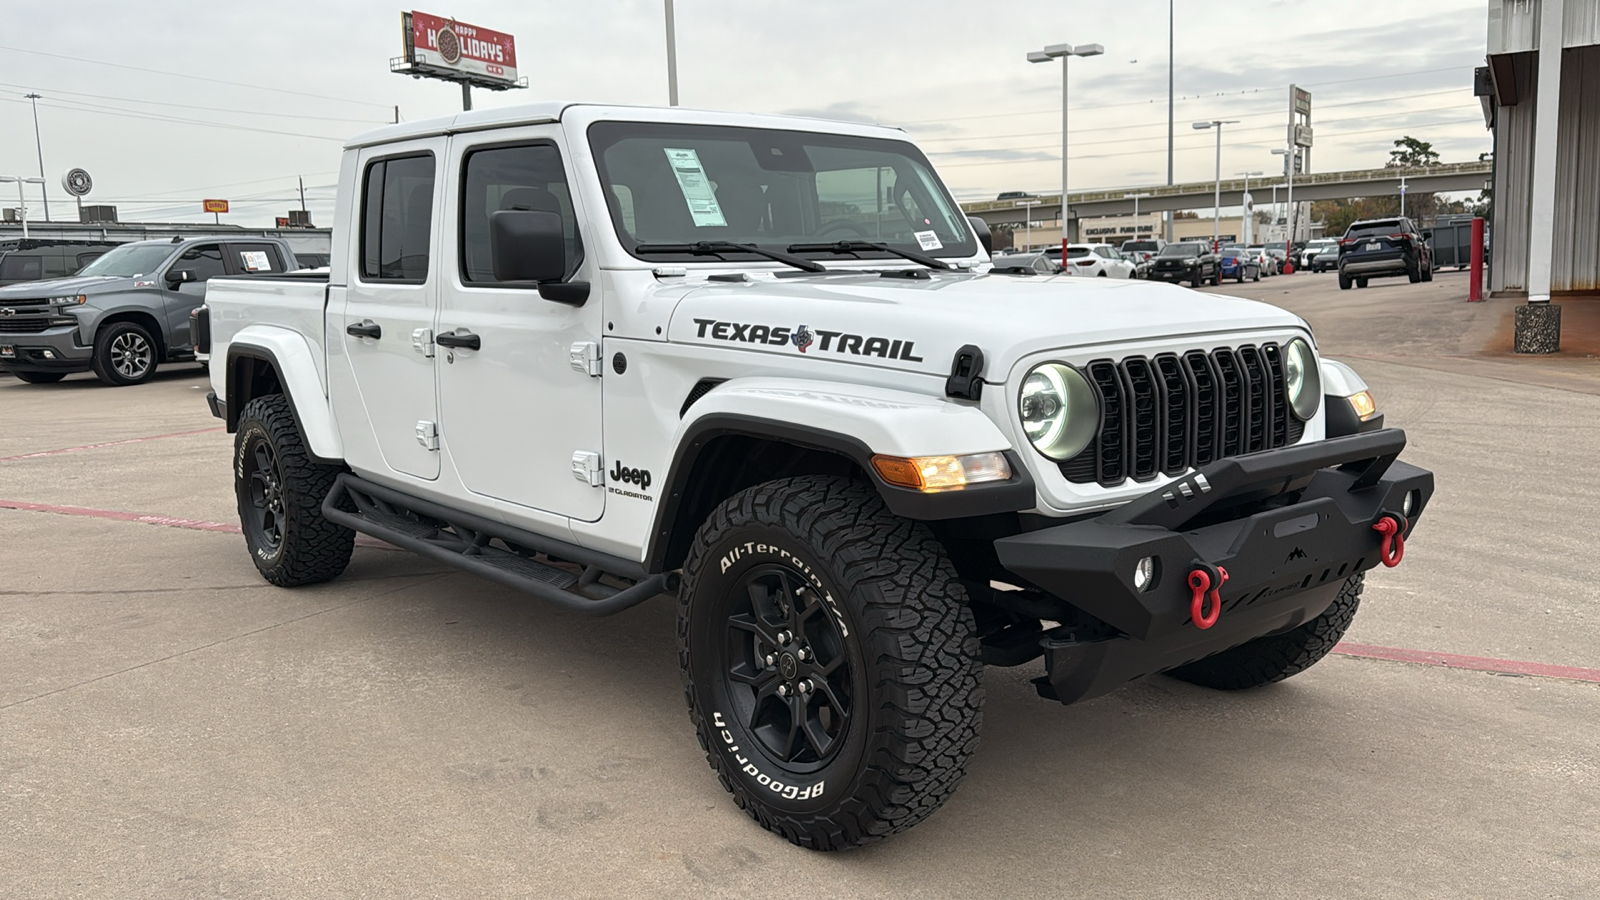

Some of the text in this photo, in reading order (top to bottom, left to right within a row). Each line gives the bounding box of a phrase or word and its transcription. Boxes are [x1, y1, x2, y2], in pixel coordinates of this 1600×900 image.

[455, 24, 477, 38] HAPPY
[1086, 225, 1153, 235] EXCLUSIVE FURNTURE
[693, 318, 924, 363] TEXAS TRAIL
[610, 460, 651, 490] Jeep
[615, 488, 653, 502] GLADIATOR
[720, 541, 849, 638] All-Terrain T/A
[713, 711, 825, 800] BFGoodrich
